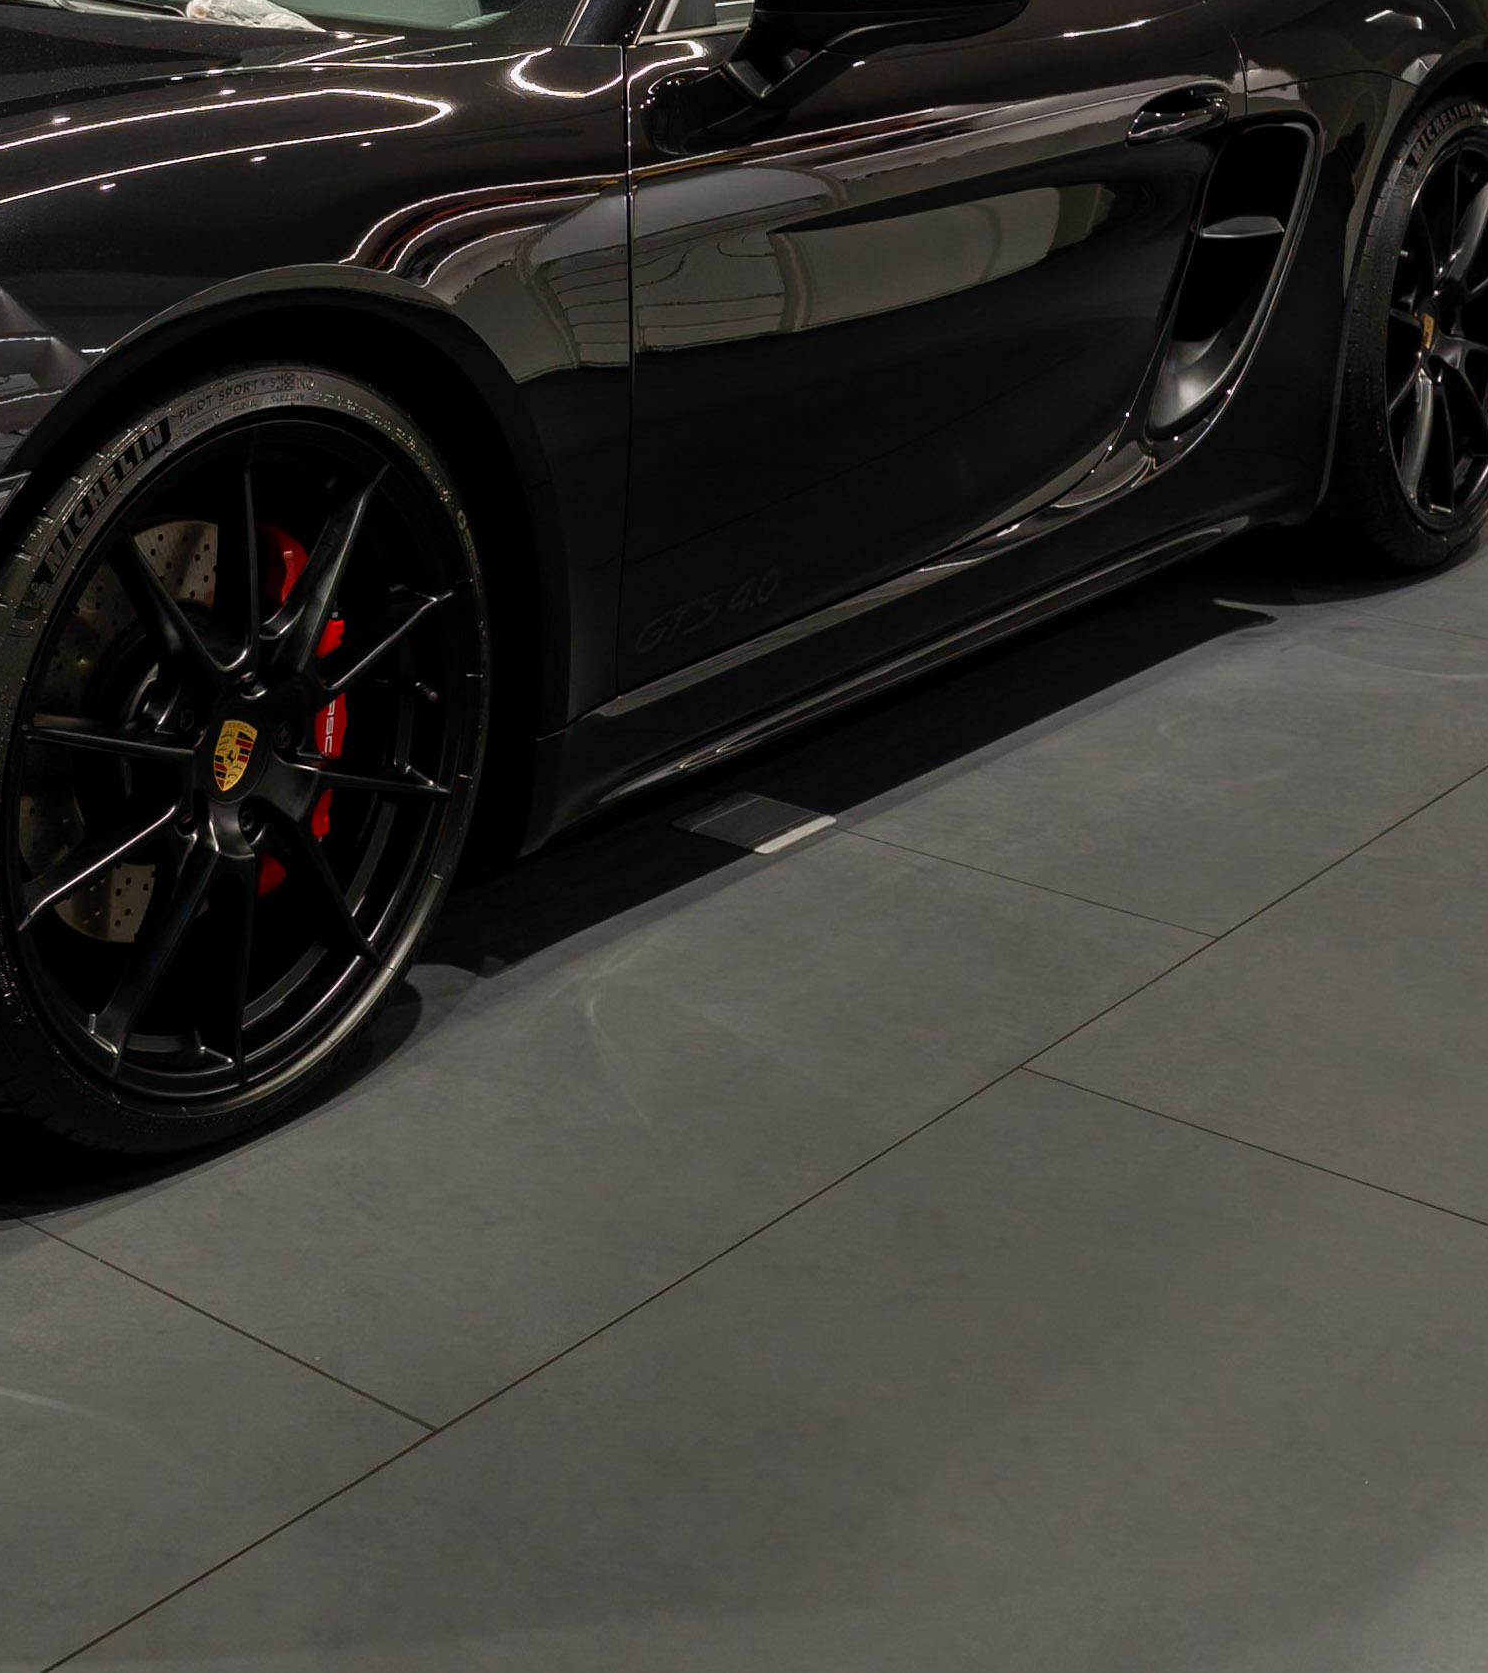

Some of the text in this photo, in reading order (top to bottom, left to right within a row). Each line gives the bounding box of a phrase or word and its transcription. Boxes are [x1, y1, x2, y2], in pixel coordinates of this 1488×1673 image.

[1410, 102, 1469, 164] MICHELIN
[178, 394, 213, 422] PILOT
[218, 379, 259, 402] SPORT
[43, 422, 167, 574] MICHELIN
